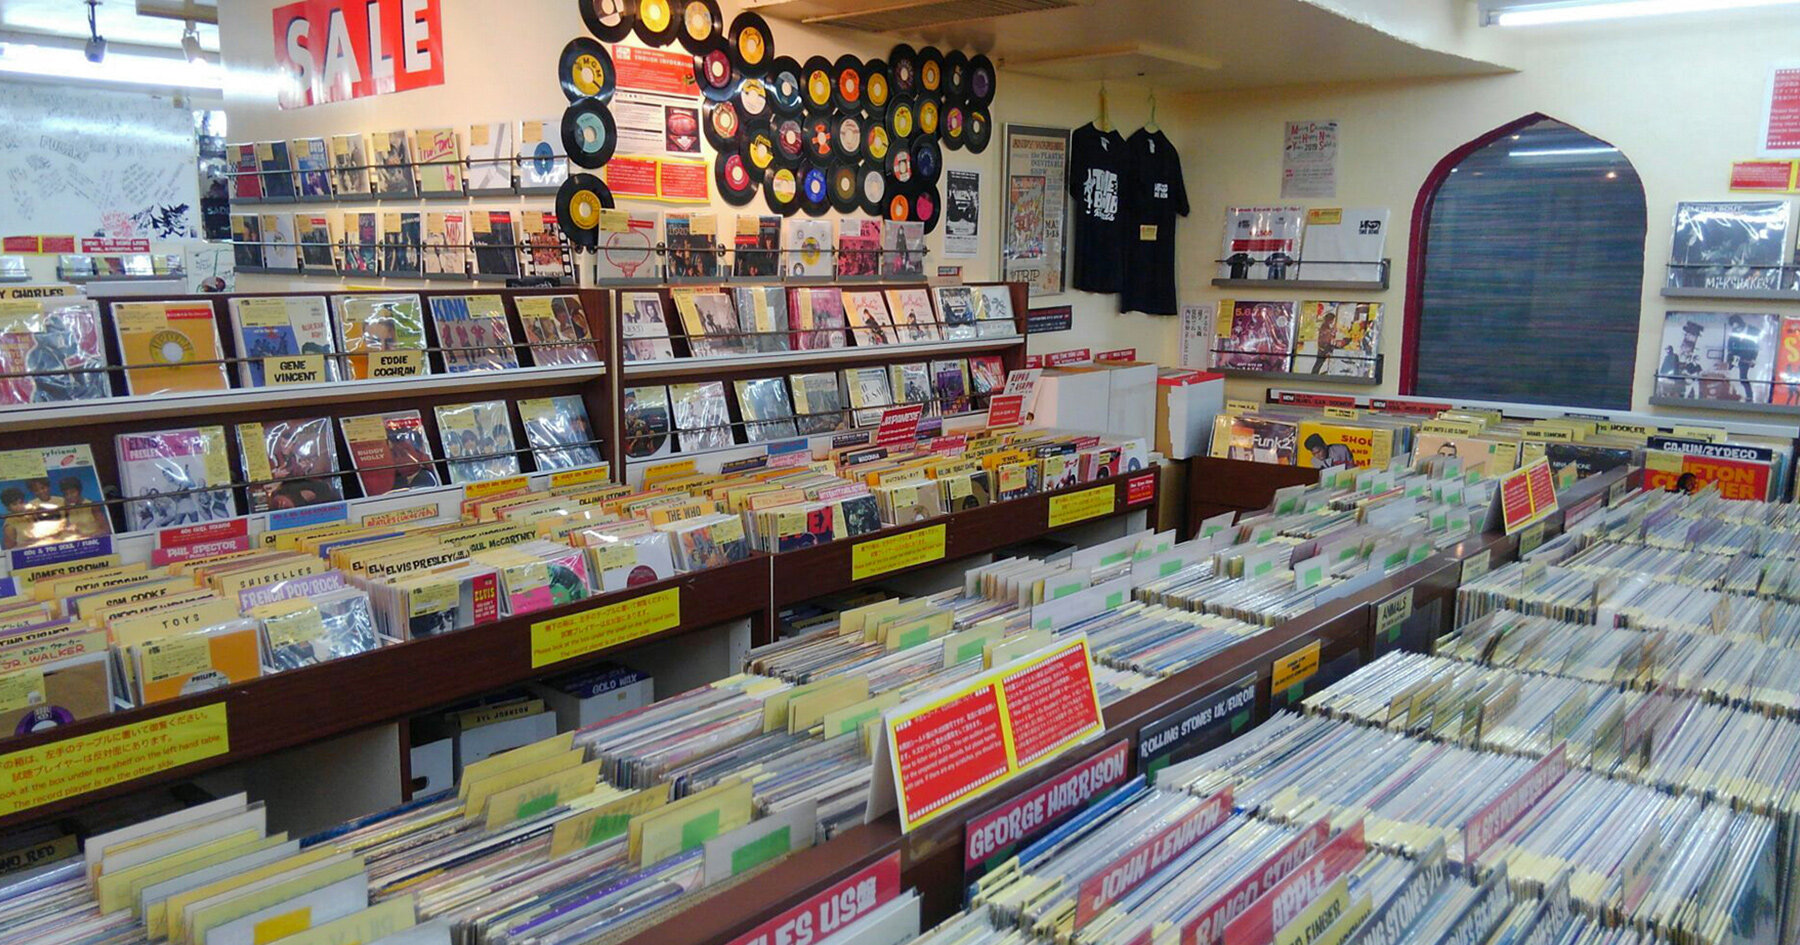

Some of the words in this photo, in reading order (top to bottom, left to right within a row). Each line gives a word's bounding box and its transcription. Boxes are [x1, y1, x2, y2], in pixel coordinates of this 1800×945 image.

[287, 0, 431, 91] SALE
[12, 288, 65, 299] CHARLES
[279, 360, 307, 371] GENE
[381, 355, 409, 366] EDDIE
[274, 370, 318, 382] VINCENT
[374, 366, 416, 377] COCHRAN
[666, 509, 682, 523] THE
[684, 505, 702, 519] WHO
[386, 560, 413, 575] ELVIS
[240, 566, 313, 588] SHIRELLES
[241, 586, 285, 610] FRENCH
[287, 574, 340, 602] POP/ROCK
[473, 588, 495, 602] ELVIS
[162, 614, 201, 630] TOYS
[29, 644, 85, 664] WALKER
[191, 671, 218, 683] PHILIPS
[1140, 726, 1179, 758] ROLLING
[1180, 710, 1212, 737] STONES
[970, 793, 1046, 860] GEORGE
[1046, 749, 1125, 818] HARRISON
[1092, 848, 1149, 912] JOHN
[1150, 799, 1221, 870] LENNON
[1272, 859, 1327, 932] APPLE
